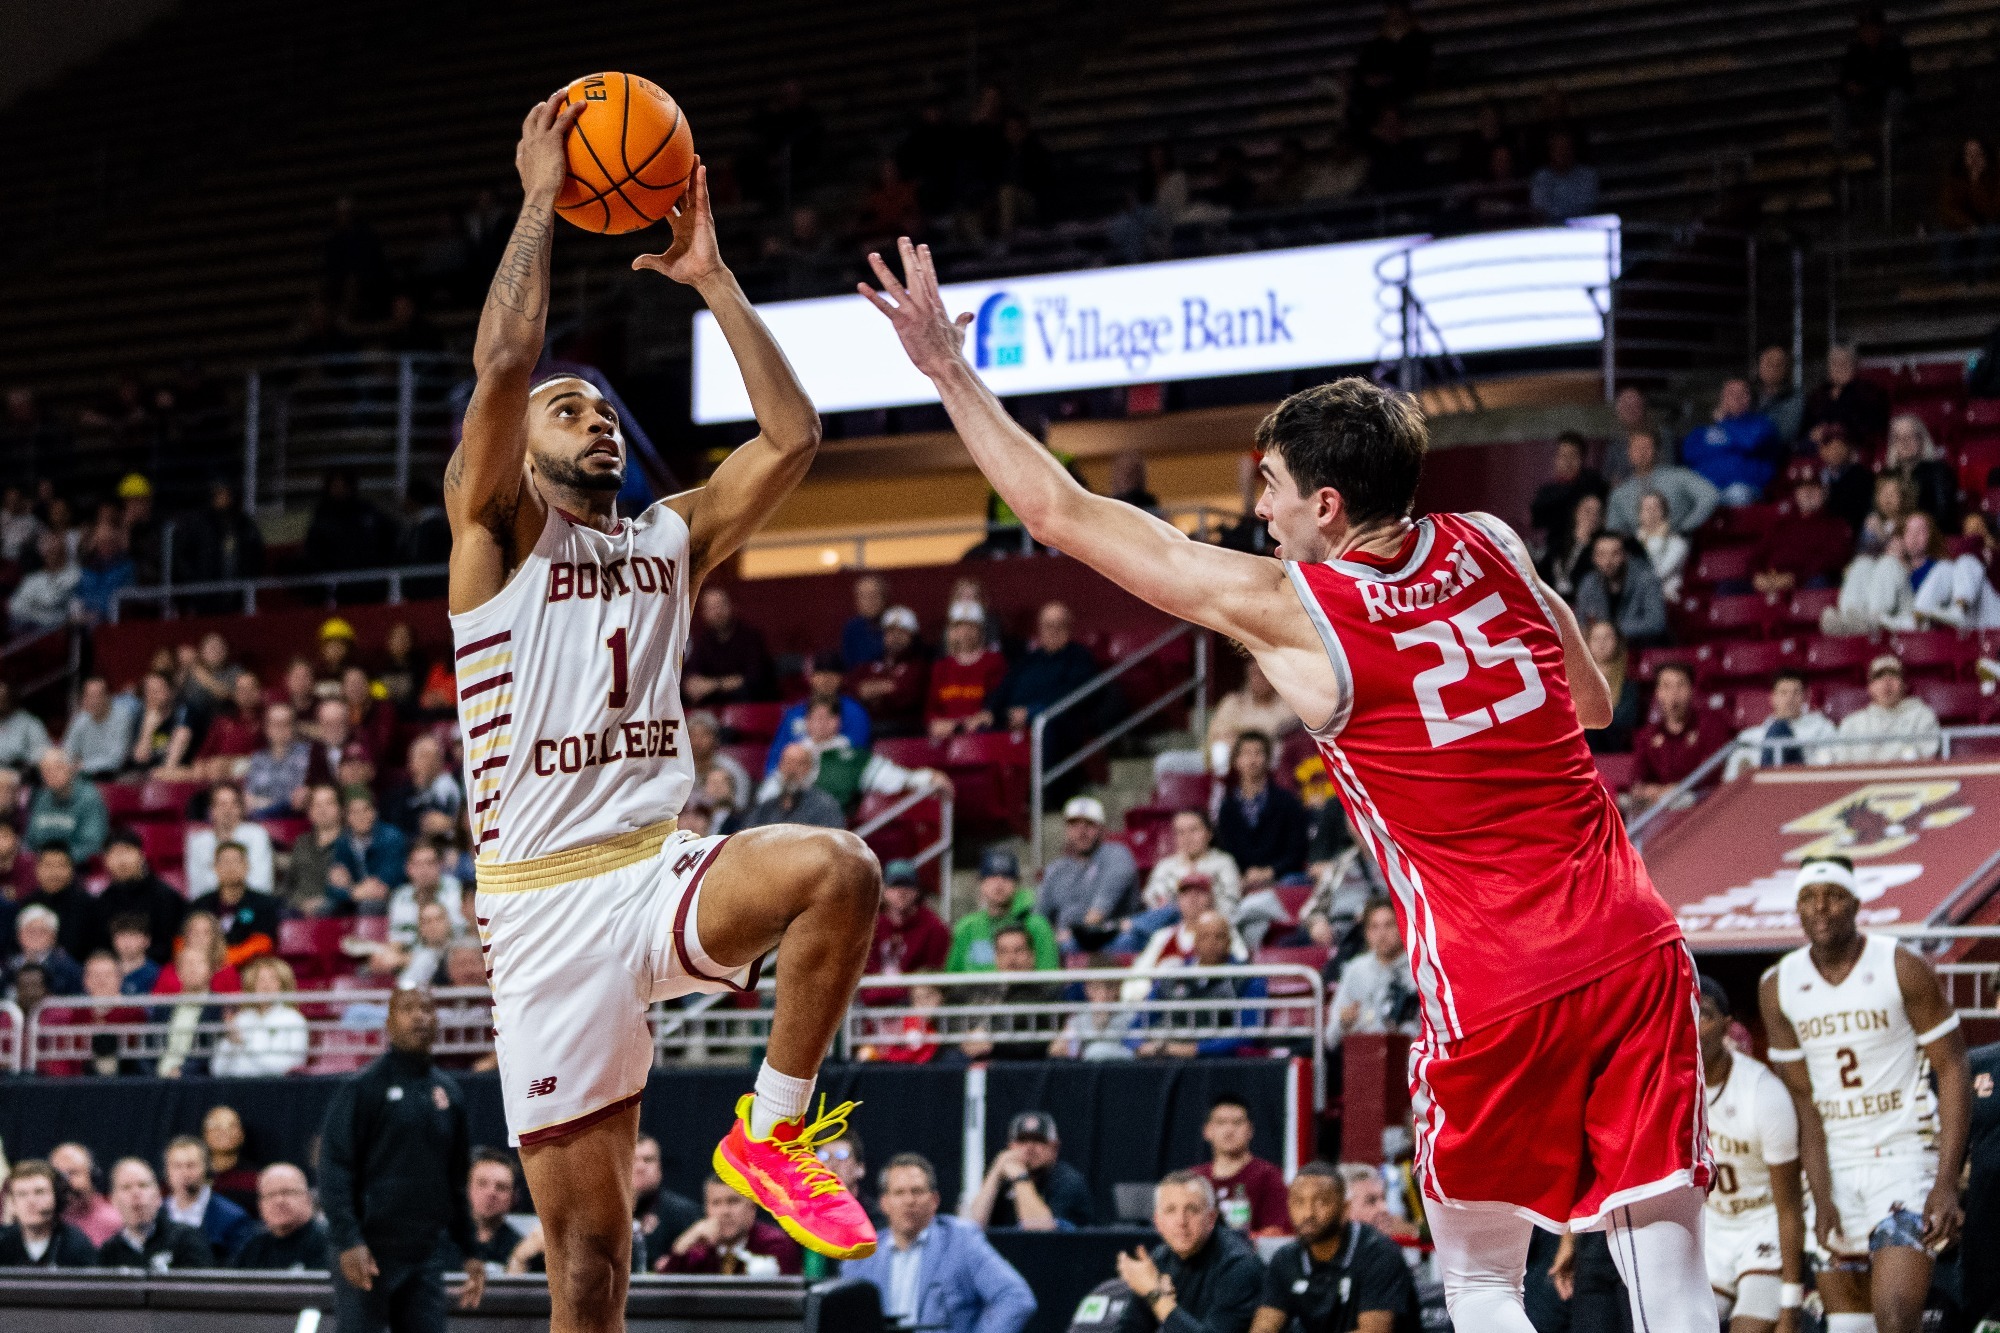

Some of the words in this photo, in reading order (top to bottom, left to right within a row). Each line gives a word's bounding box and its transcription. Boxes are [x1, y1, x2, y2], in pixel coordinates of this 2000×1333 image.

[1033, 307, 1173, 375] Village
[1181, 289, 1293, 352] Bank
[548, 555, 676, 603] BOSTON
[1355, 539, 1486, 624] RUGAN
[606, 627, 629, 709] 1
[1390, 591, 1547, 749] 25
[534, 719, 679, 777] COLLEGE
[1798, 1008, 1889, 1041] BOSTON
[1836, 1047, 1863, 1089] 2
